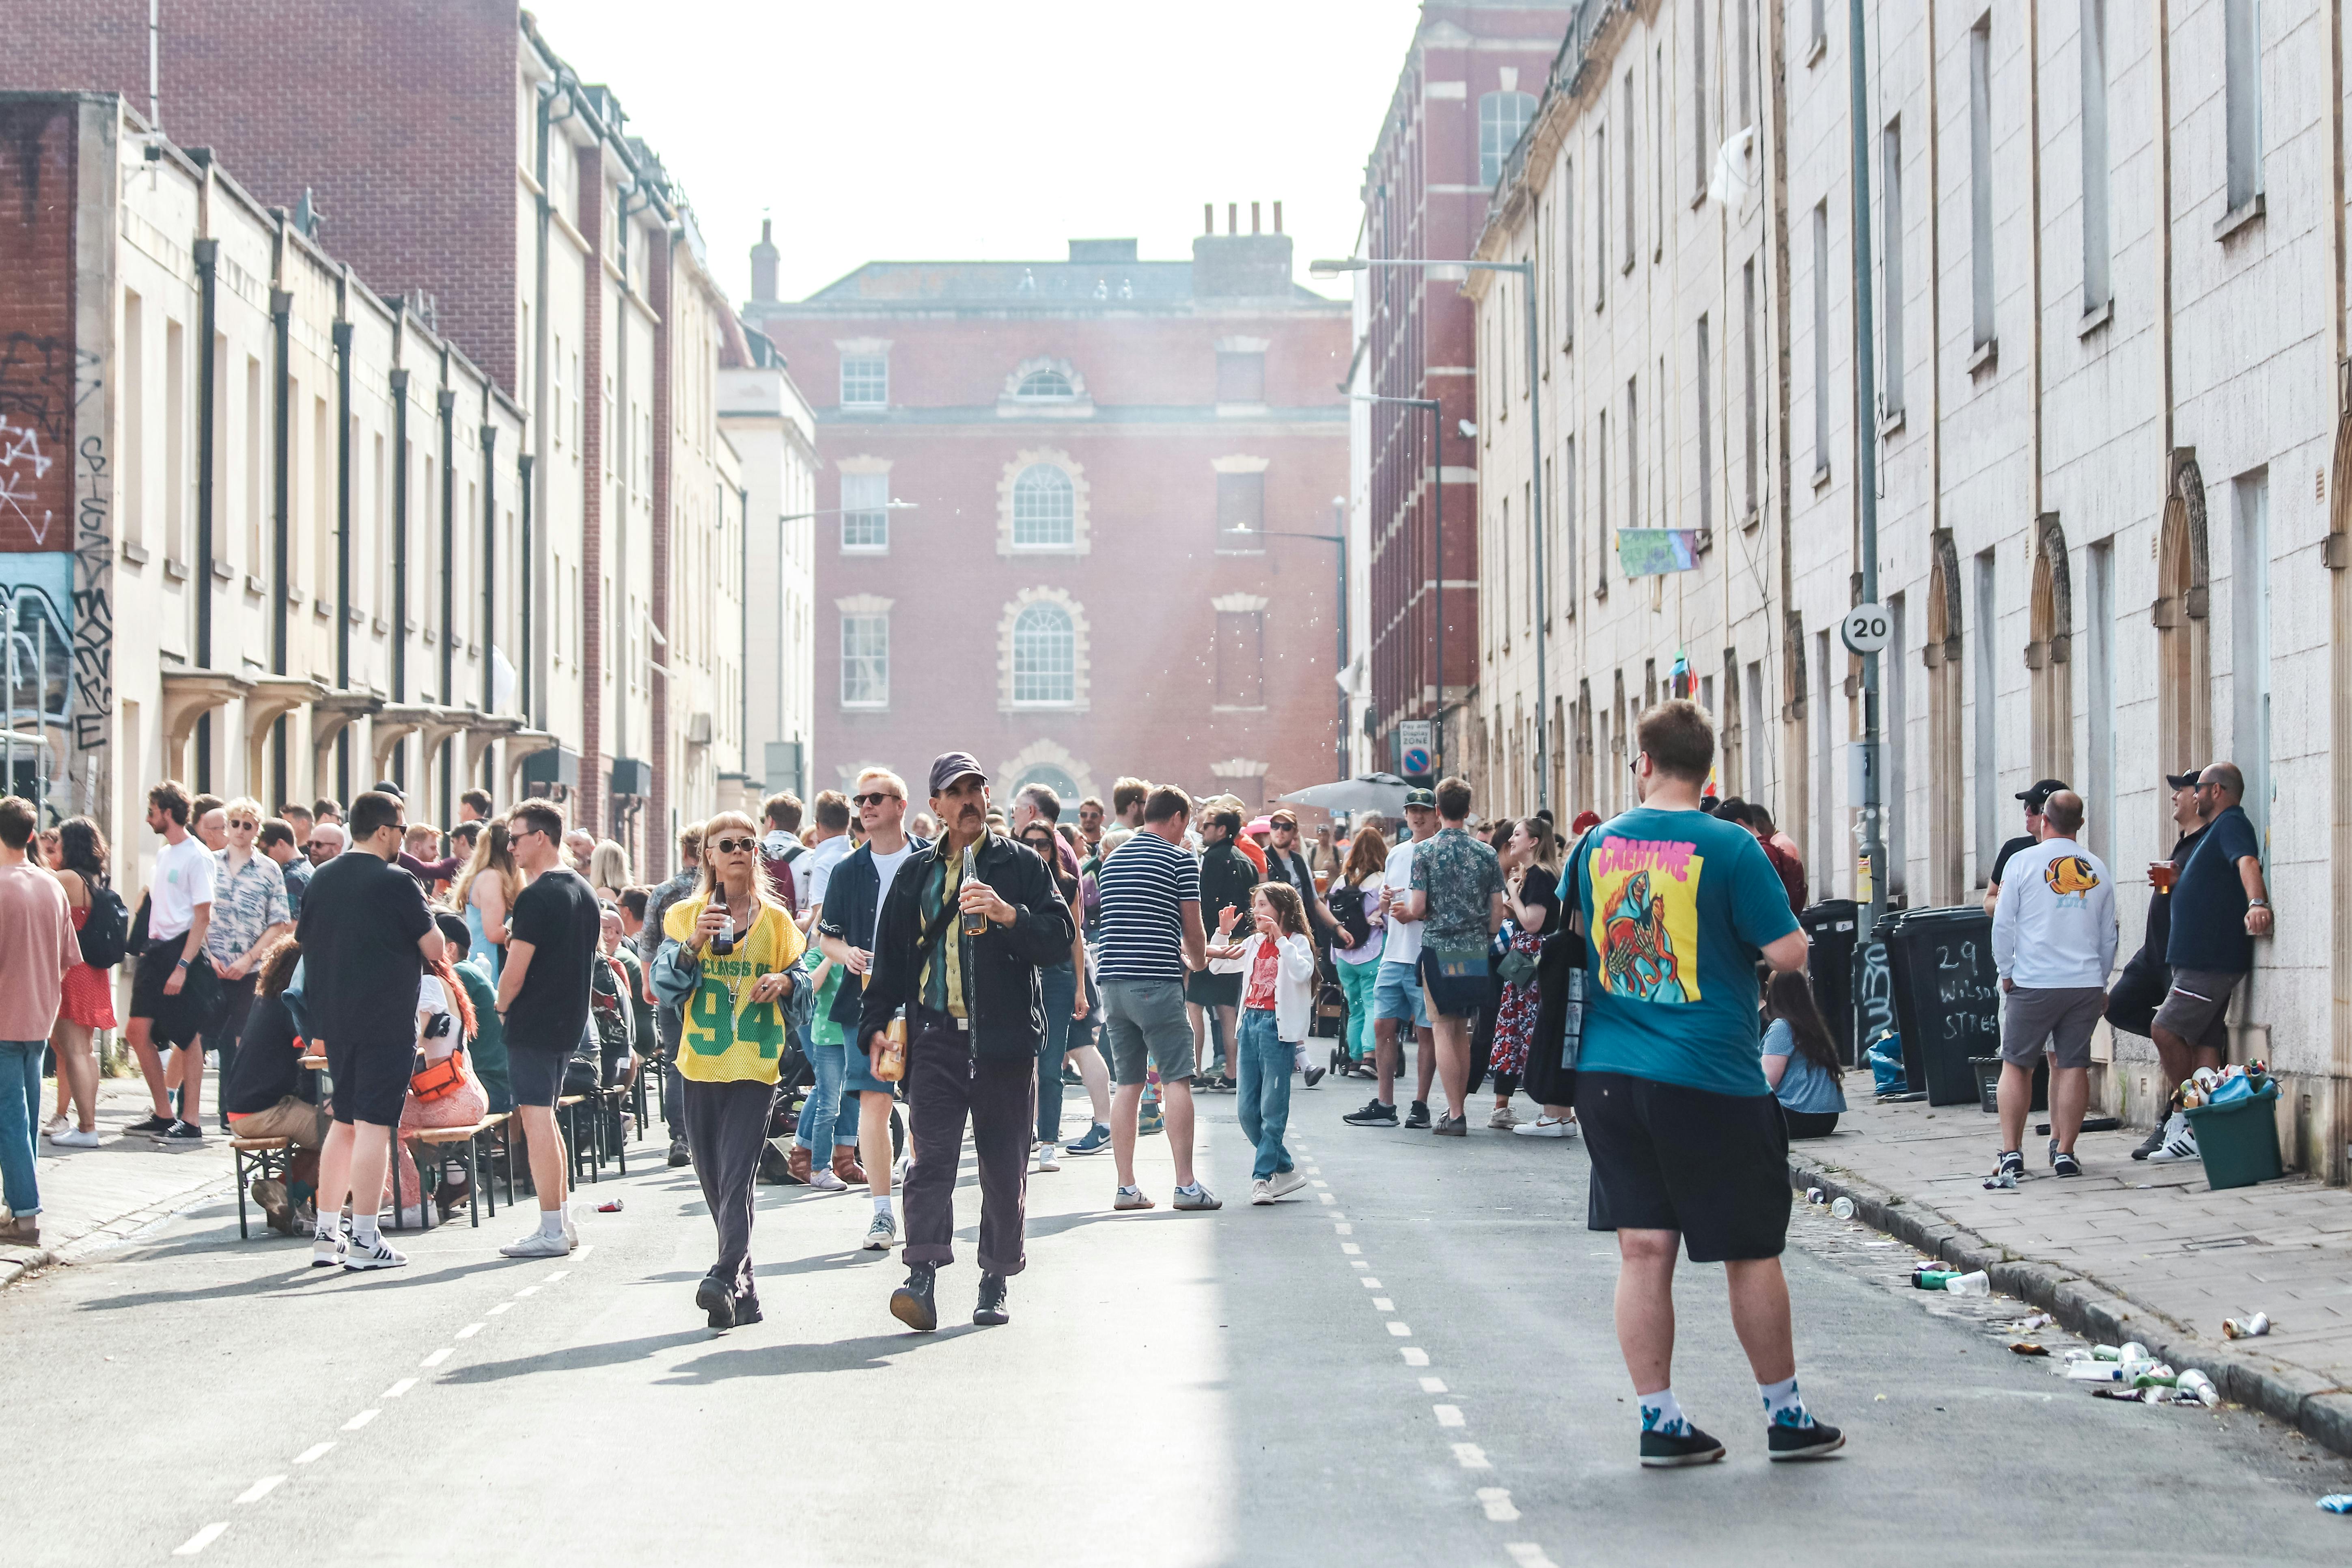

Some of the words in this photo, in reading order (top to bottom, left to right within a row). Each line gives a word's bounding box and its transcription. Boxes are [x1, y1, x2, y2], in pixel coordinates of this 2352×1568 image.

[1853, 617, 1886, 637] 20
[1598, 835, 1697, 882] CREATURE
[700, 958, 752, 977] CLASS
[1936, 940, 1978, 976] 29
[687, 977, 785, 1059] 94
[1943, 1011, 1996, 1039] STREE
